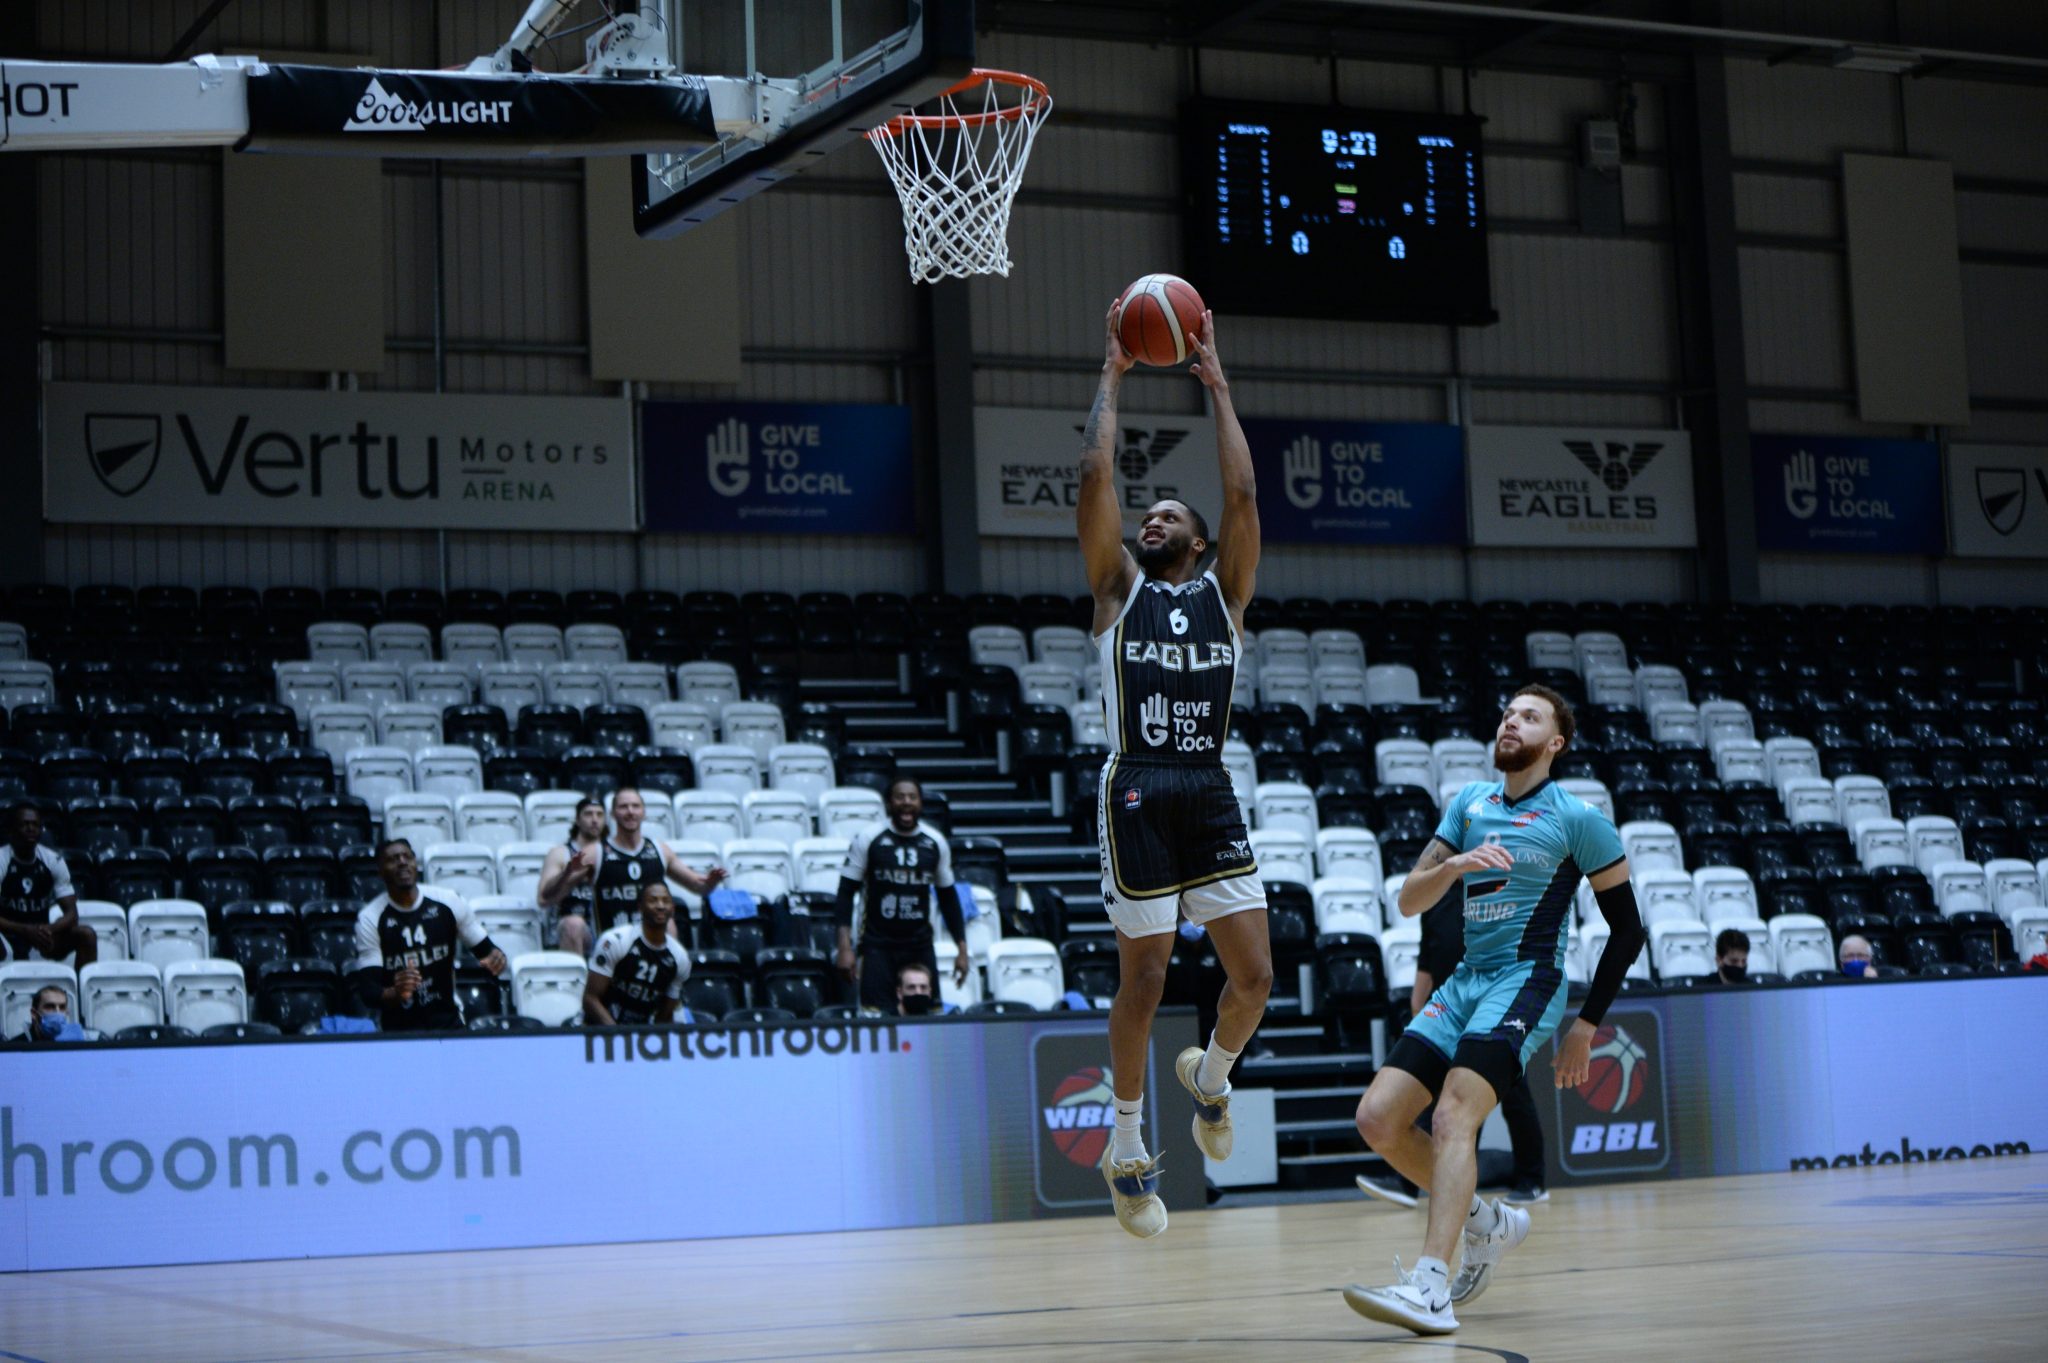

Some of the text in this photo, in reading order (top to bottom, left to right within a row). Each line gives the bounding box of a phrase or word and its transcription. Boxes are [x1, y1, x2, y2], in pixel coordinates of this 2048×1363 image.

[355, 93, 513, 126] Coors LIGHT
[760, 424, 821, 447] GIVE
[176, 413, 439, 499] Vertu
[460, 437, 609, 465] Motors
[761, 449, 799, 470] TO
[1330, 441, 1384, 463] GIVE
[1002, 465, 1080, 479] NEWCAS
[1333, 464, 1366, 485] TO
[1824, 456, 1871, 477] GIVE
[463, 481, 555, 501] ARENA
[765, 473, 852, 496] LOCAL
[1499, 478, 1590, 493] NEWCASTLE
[1827, 478, 1855, 496] TO
[1335, 486, 1413, 509] LOCAL
[1500, 494, 1657, 519] EAGLES
[1829, 499, 1896, 519] LOCAL
[1169, 608, 1189, 635] 6
[1124, 641, 1234, 672] EAGLES
[1172, 701, 1211, 717] GIVE
[1173, 718, 1197, 734] TO
[894, 846, 919, 868] 13
[627, 860, 642, 881] 0
[401, 924, 428, 949] 14
[635, 960, 659, 985] 21
[1570, 1120, 1659, 1155] BBL
[1, 1106, 522, 1197] hroom.com
